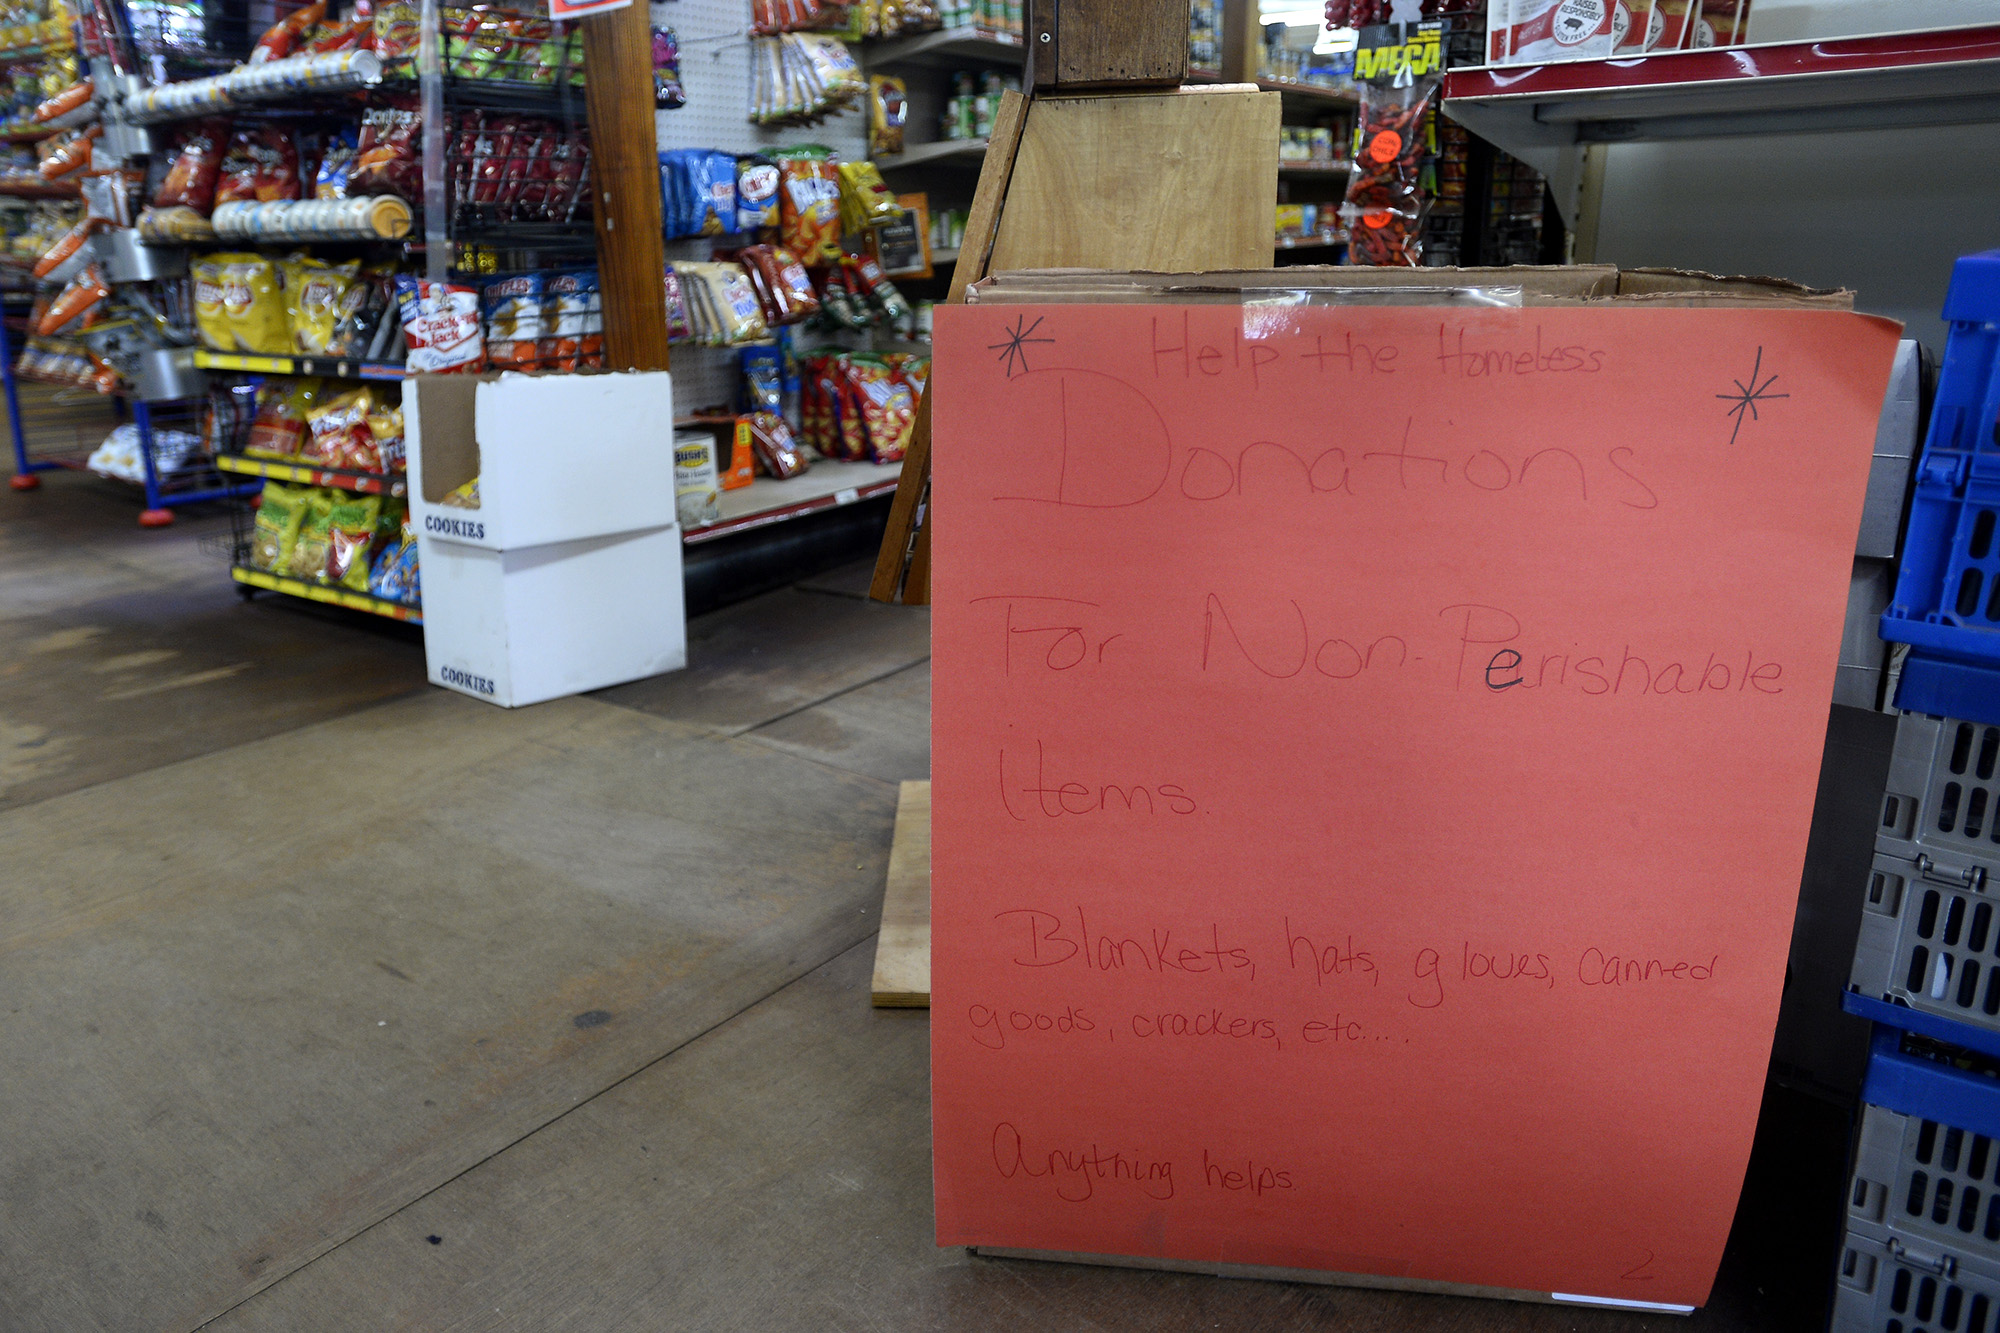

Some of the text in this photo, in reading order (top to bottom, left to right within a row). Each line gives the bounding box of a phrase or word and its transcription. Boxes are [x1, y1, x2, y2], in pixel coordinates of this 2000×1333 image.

[1561, 4, 1603, 21] RESPONSIBLY
[1570, 30, 1588, 42] FREE
[417, 311, 479, 334] Crackr
[424, 328, 460, 348] Jack
[1152, 309, 1606, 390] Help the Homeless
[992, 367, 1658, 510] Donations
[425, 515, 485, 540] COOKIES
[969, 595, 1123, 678] For
[441, 666, 495, 695] COOKIES
[994, 905, 1256, 981] Blankets,
[1285, 916, 1380, 987] hats,
[968, 1003, 1114, 1050] goods,
[1132, 1008, 1281, 1050] crackers,
[992, 1121, 1175, 1202] Anything
[1620, 1248, 1655, 1280] 2
